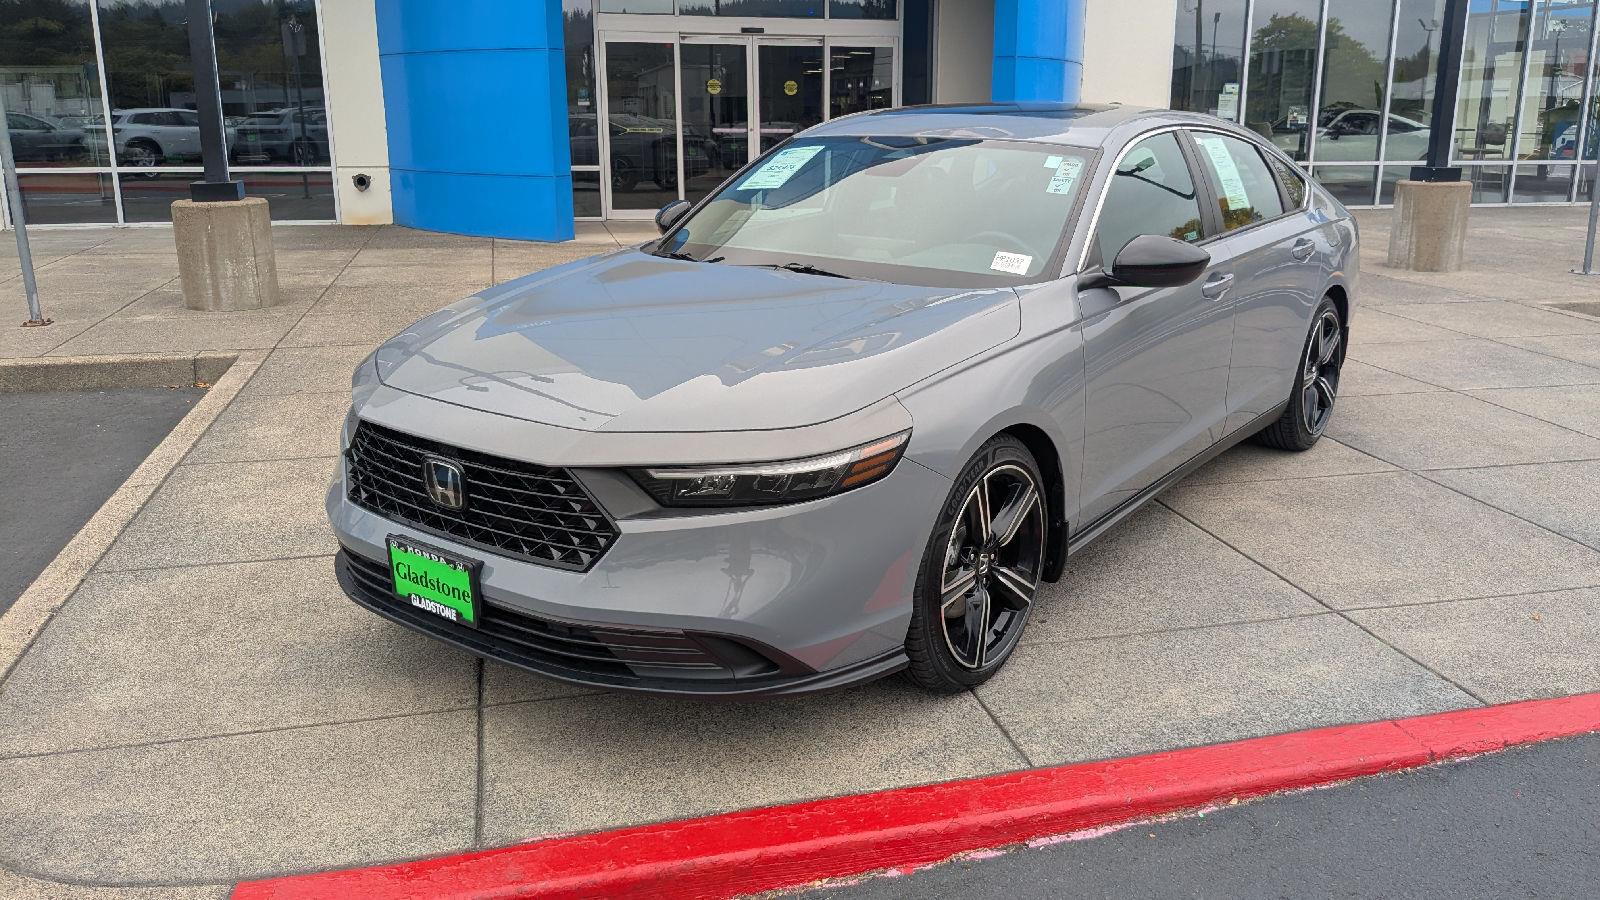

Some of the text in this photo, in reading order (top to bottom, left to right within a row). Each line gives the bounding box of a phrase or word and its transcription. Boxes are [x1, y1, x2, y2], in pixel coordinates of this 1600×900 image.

[946, 460, 985, 516] GOODYEAR
[407, 545, 447, 565] HONDA
[395, 561, 471, 604] Gladstone
[411, 593, 457, 621] GLADSTONE
